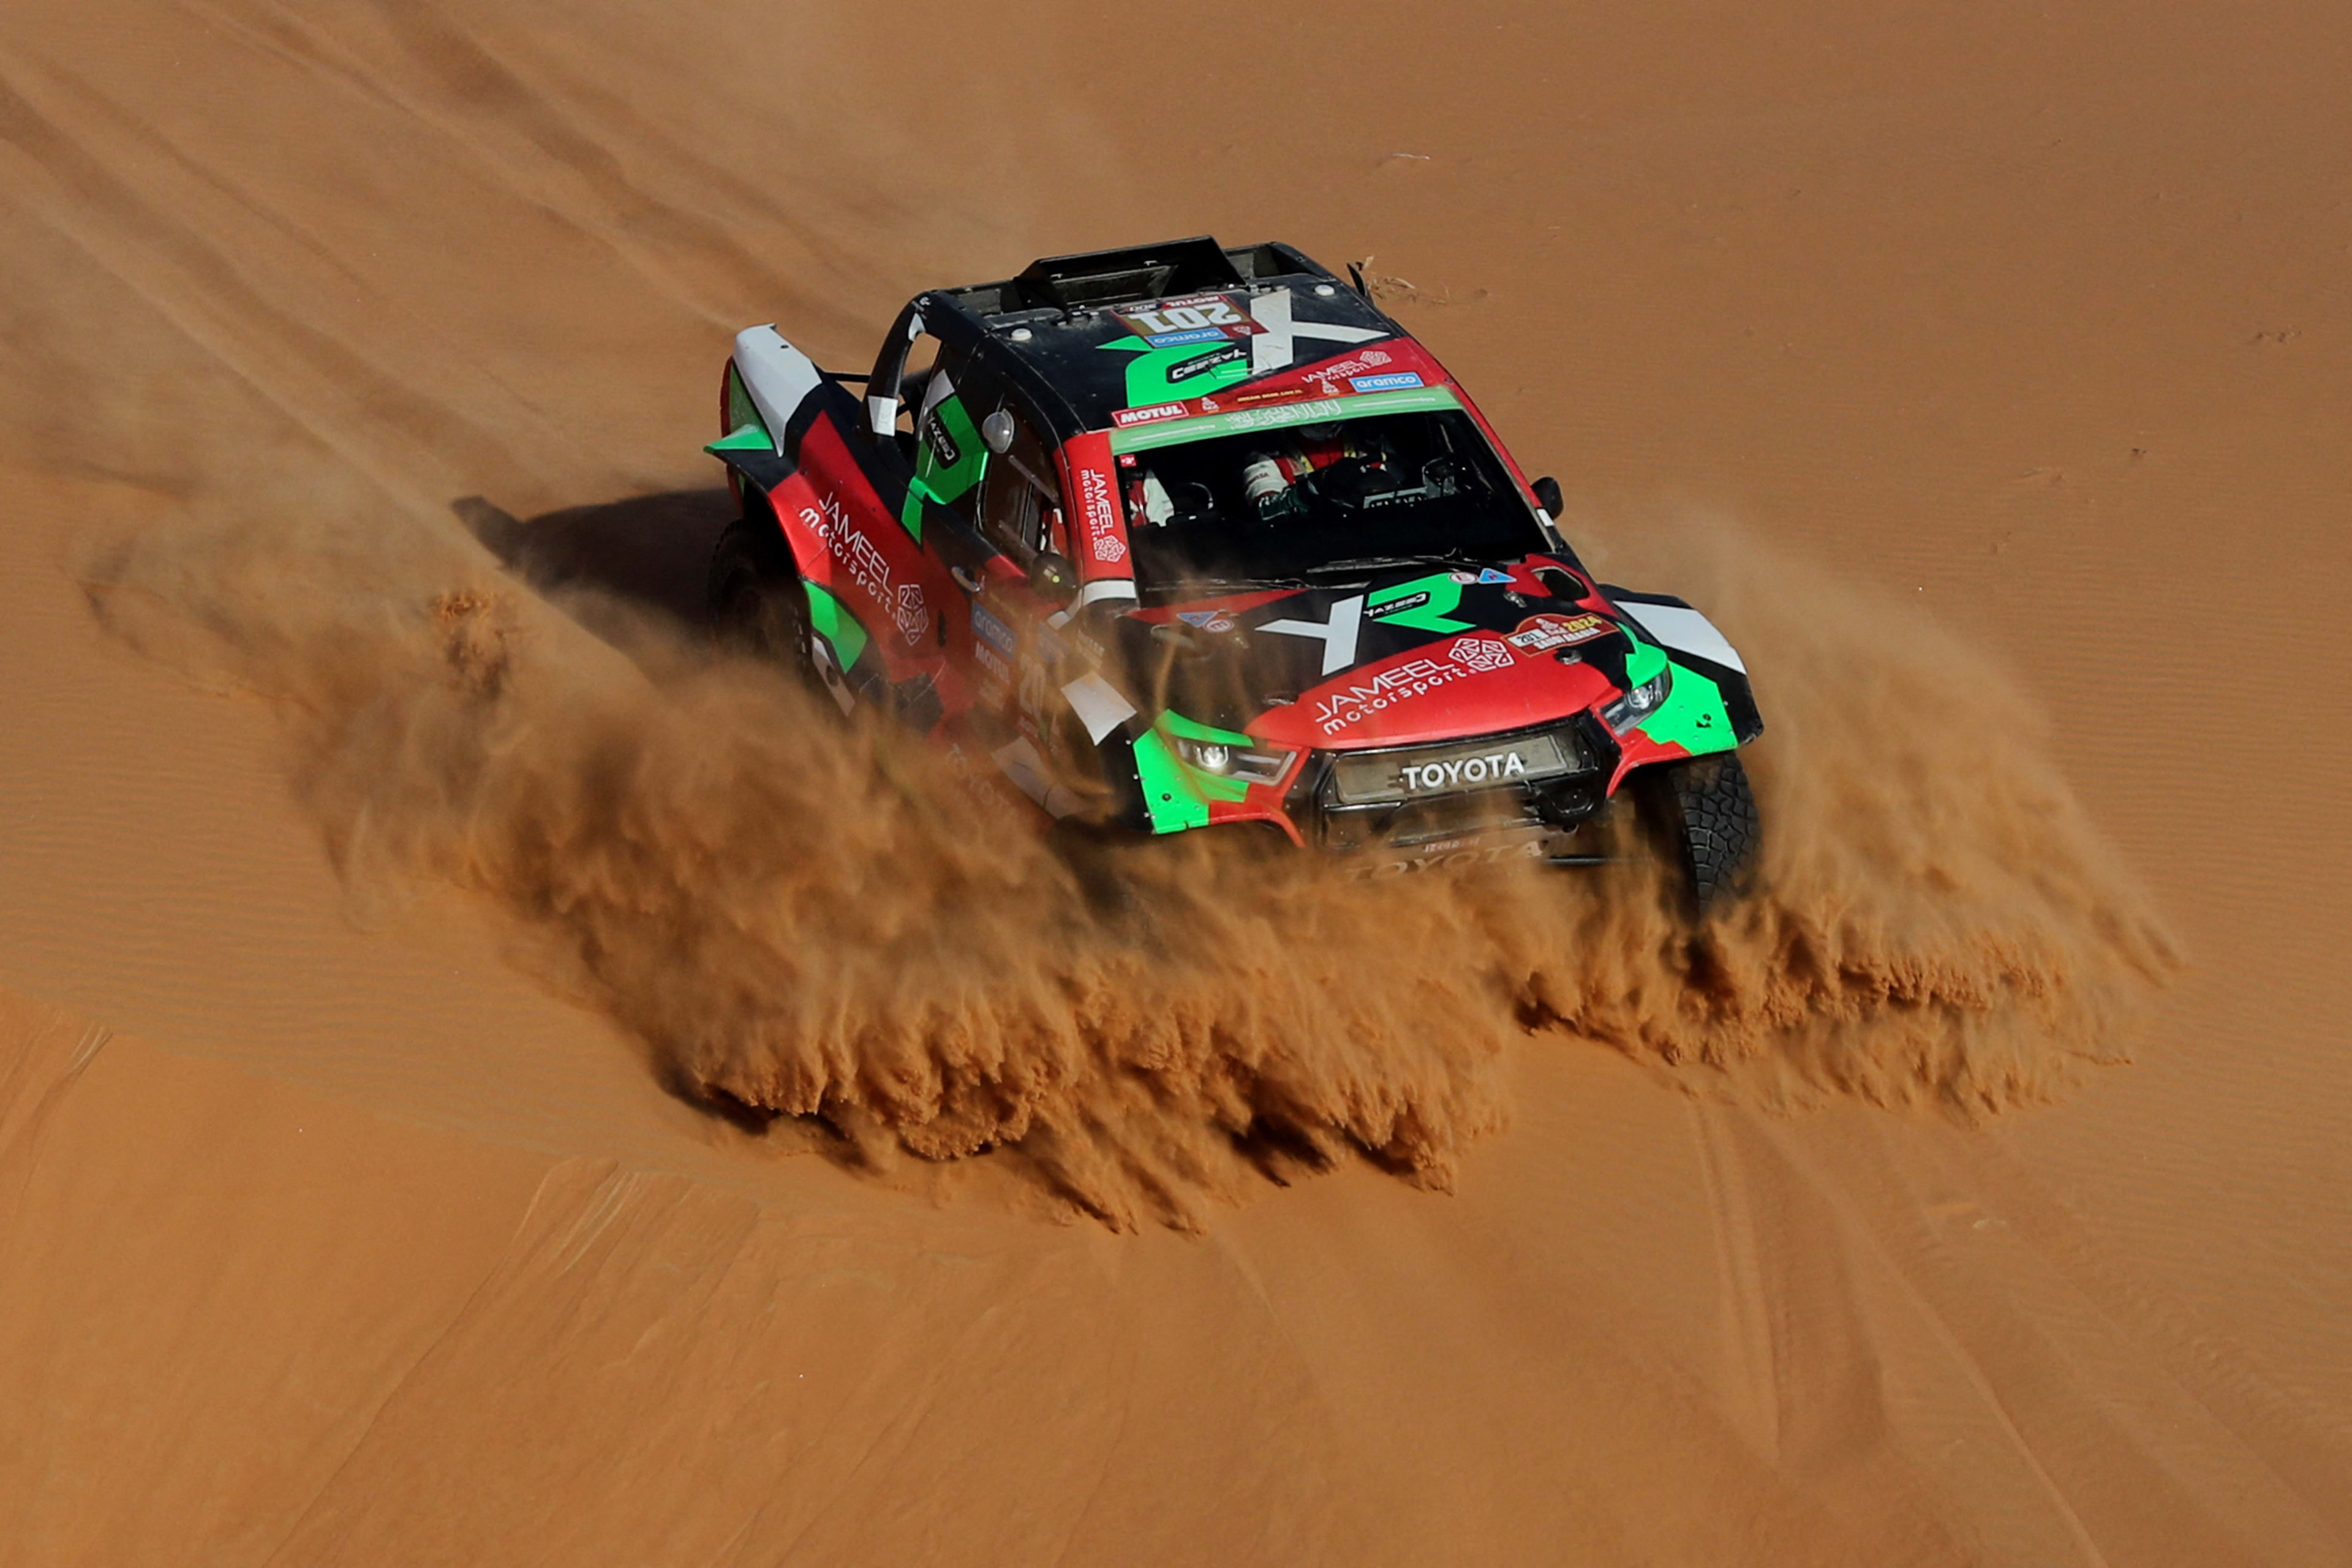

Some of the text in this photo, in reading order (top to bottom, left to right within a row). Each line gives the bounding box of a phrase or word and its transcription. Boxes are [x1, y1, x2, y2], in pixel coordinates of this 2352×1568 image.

[1166, 295, 1220, 307] MOTUL
[1128, 302, 1242, 333] 201
[1154, 331, 1219, 344] aramco
[1356, 375, 1417, 388] aramco
[1120, 404, 1183, 424] MOTUL
[1090, 469, 1114, 535] JAMEEL
[818, 491, 894, 597] JAMEEL
[974, 610, 1014, 654] aramco
[1516, 631, 1540, 644] 201
[1562, 616, 1602, 633] 2024
[1532, 635, 1566, 650] SAUDI
[1562, 627, 1601, 643] ARABIA
[974, 640, 1011, 686] MOTUL
[1315, 658, 1455, 723] JAMEEL
[1402, 752, 1525, 790] TOYOTA
